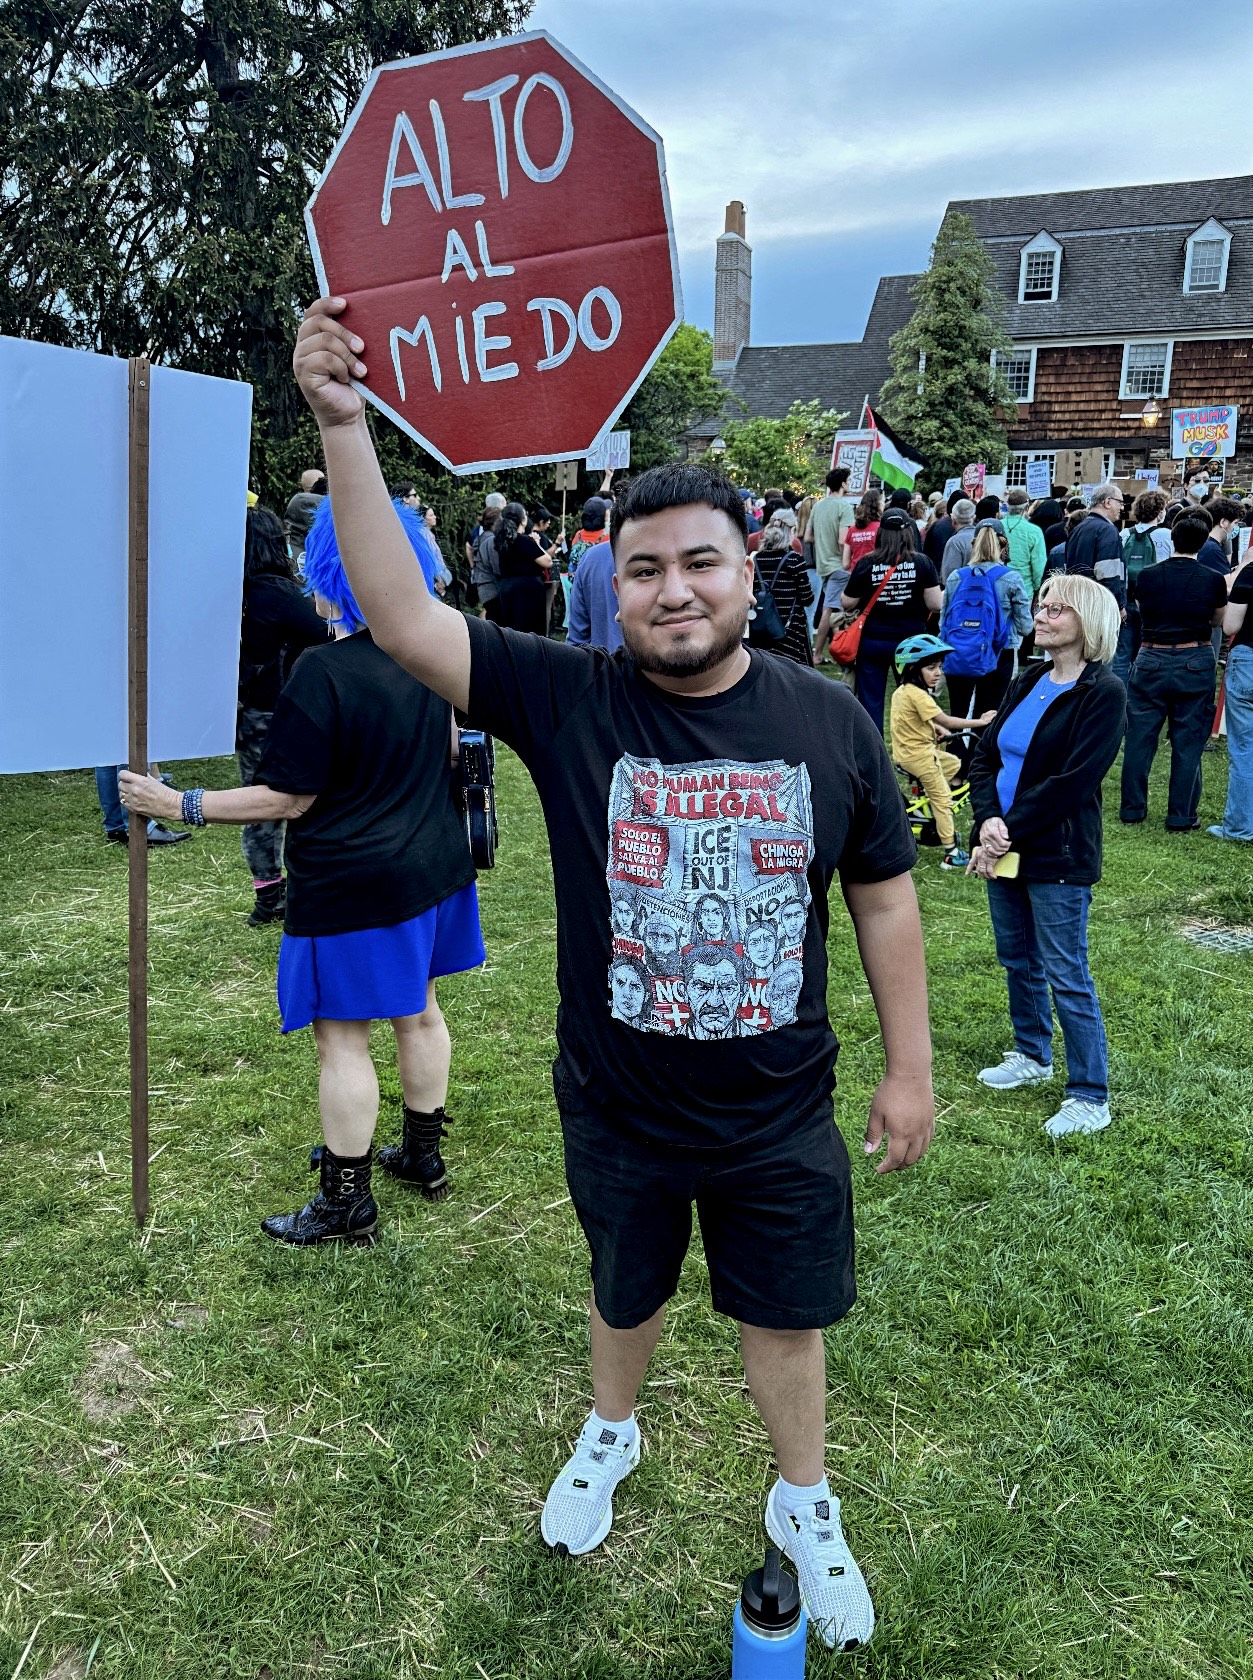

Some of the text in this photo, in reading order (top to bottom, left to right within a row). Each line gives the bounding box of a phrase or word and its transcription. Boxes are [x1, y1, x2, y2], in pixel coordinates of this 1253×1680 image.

[381, 71, 574, 225] ALTO
[441, 220, 515, 283] AL
[1175, 409, 1230, 426] TRUMP
[1182, 424, 1230, 443] MUSK
[851, 450, 866, 489] EARTH
[633, 770, 784, 794] NO HUMAN BEING
[632, 786, 788, 823] IS ILLEGAL
[621, 827, 662, 844] SOLO EL
[692, 824, 732, 856] ICE
[618, 839, 662, 856] PUEBLO
[760, 843, 804, 858] CHINGA
[618, 852, 660, 866] SALVA AL
[691, 855, 730, 867] OUT OF
[762, 857, 804, 869] LA MIGRA
[617, 862, 659, 880] PUEBLO
[691, 866, 730, 892] NJ
[746, 898, 781, 926] NO
